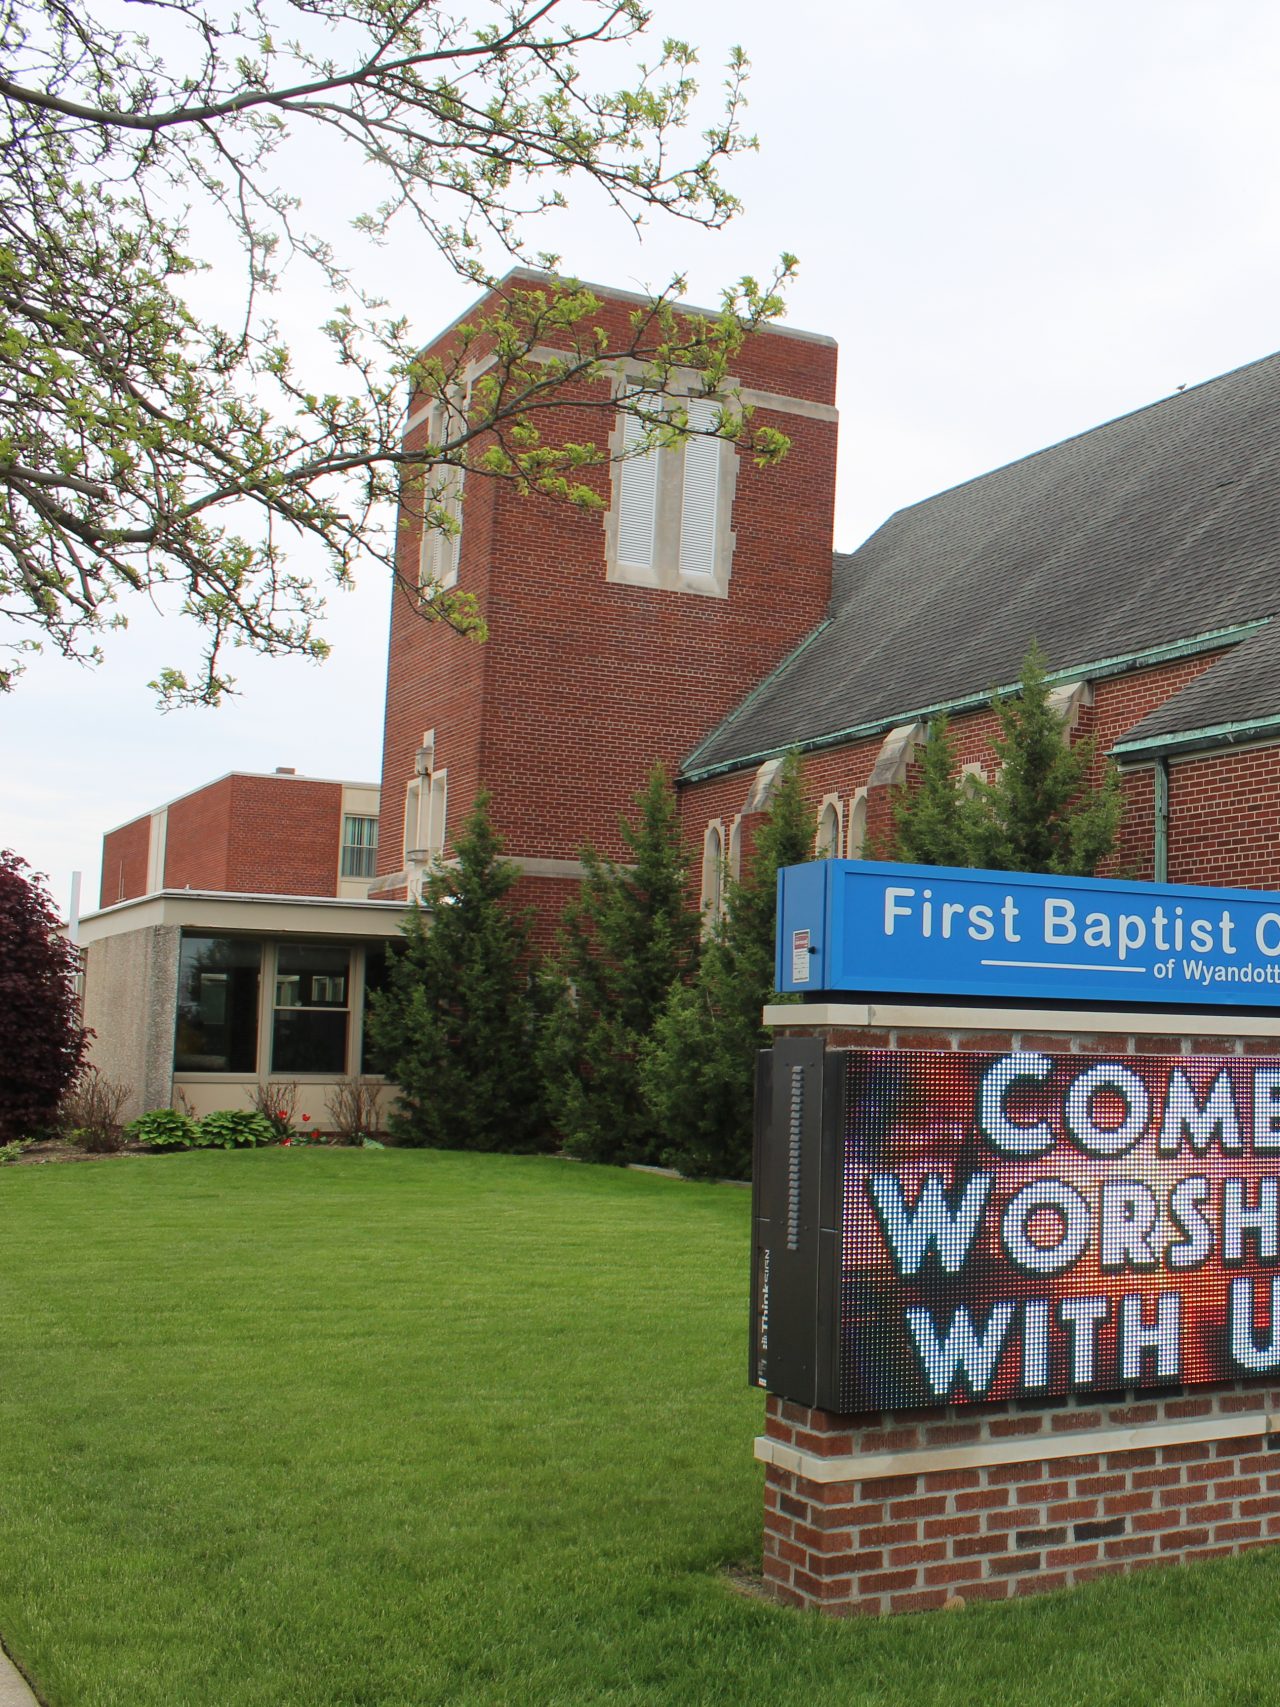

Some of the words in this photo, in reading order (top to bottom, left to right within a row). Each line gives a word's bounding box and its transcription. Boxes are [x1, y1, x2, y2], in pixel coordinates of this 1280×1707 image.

[884, 886, 1022, 943] First
[1043, 897, 1238, 961] Baptist
[1153, 957, 1176, 980] of
[905, 1290, 1181, 1396] WITH
